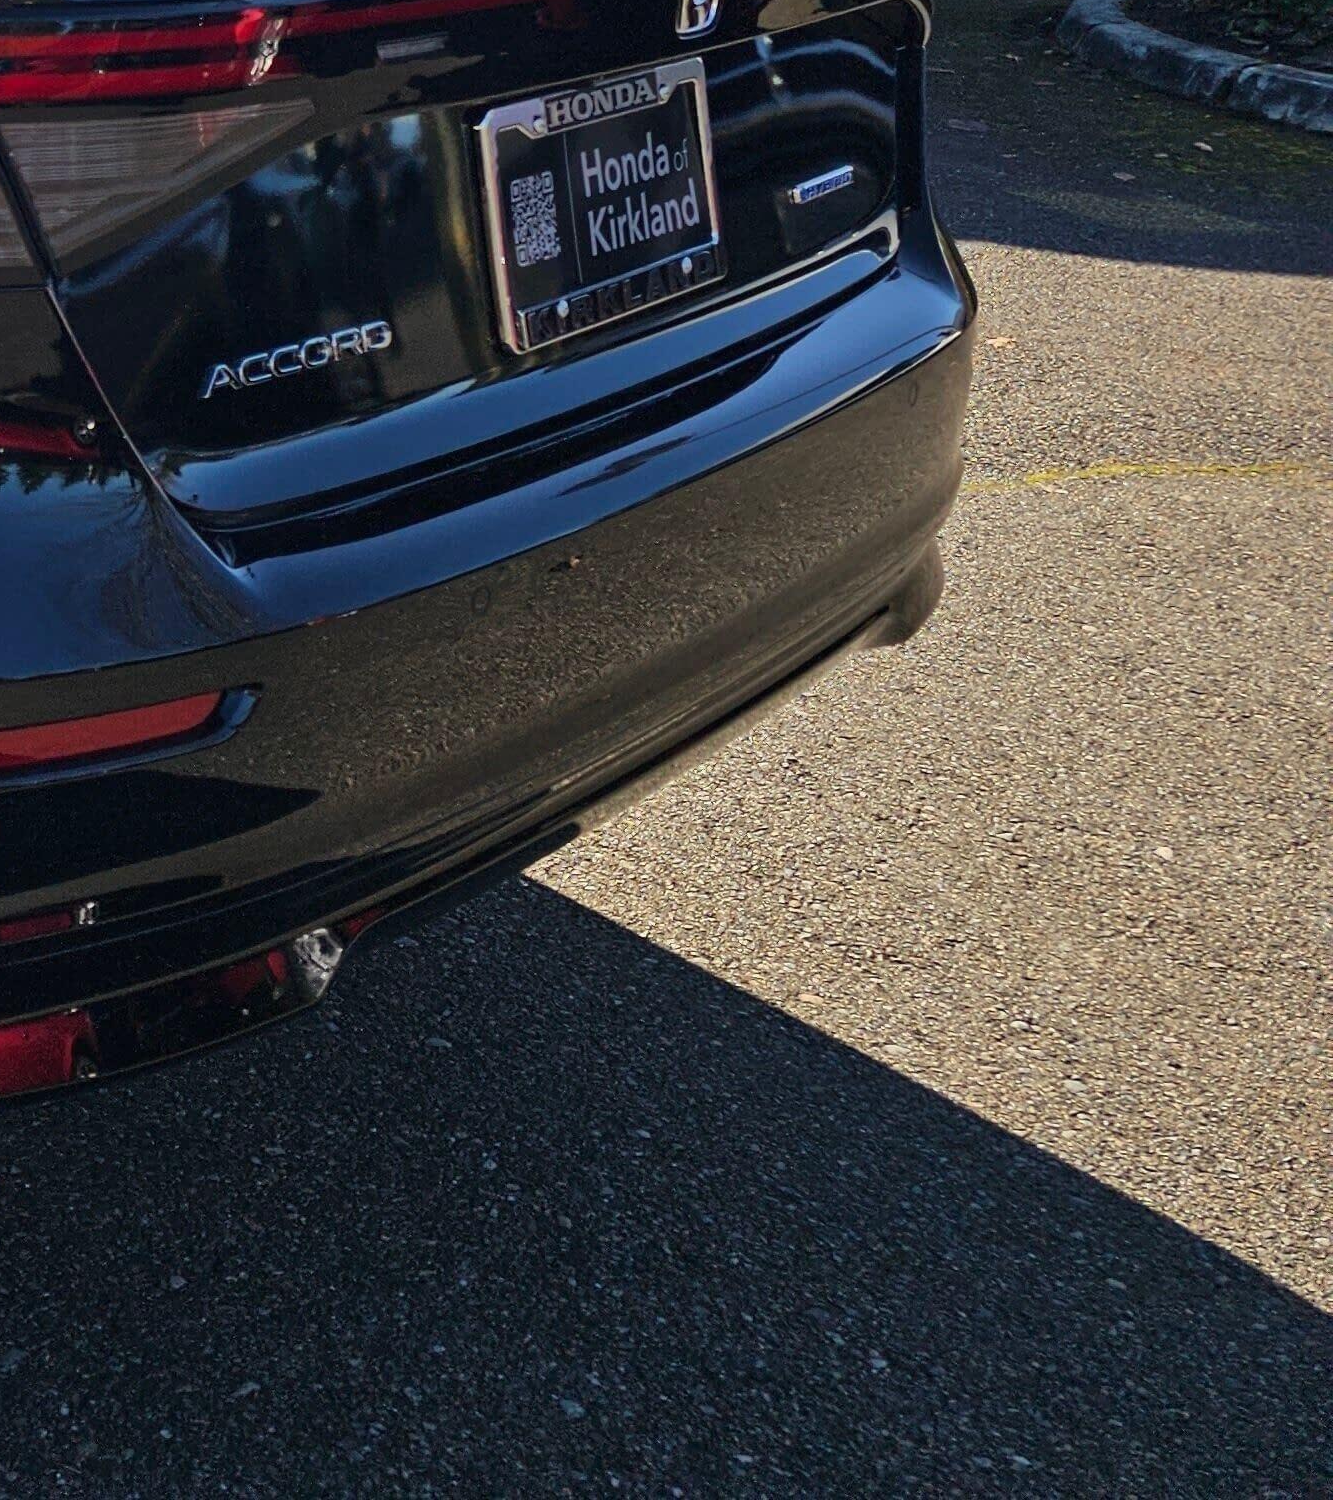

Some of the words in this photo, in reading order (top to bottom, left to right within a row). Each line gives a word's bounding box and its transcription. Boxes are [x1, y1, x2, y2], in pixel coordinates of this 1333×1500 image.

[546, 78, 657, 128] HONDA
[580, 131, 670, 198] Honda
[673, 138, 689, 172] of
[587, 177, 700, 257] Kirkland
[200, 320, 393, 399] ACCORD
